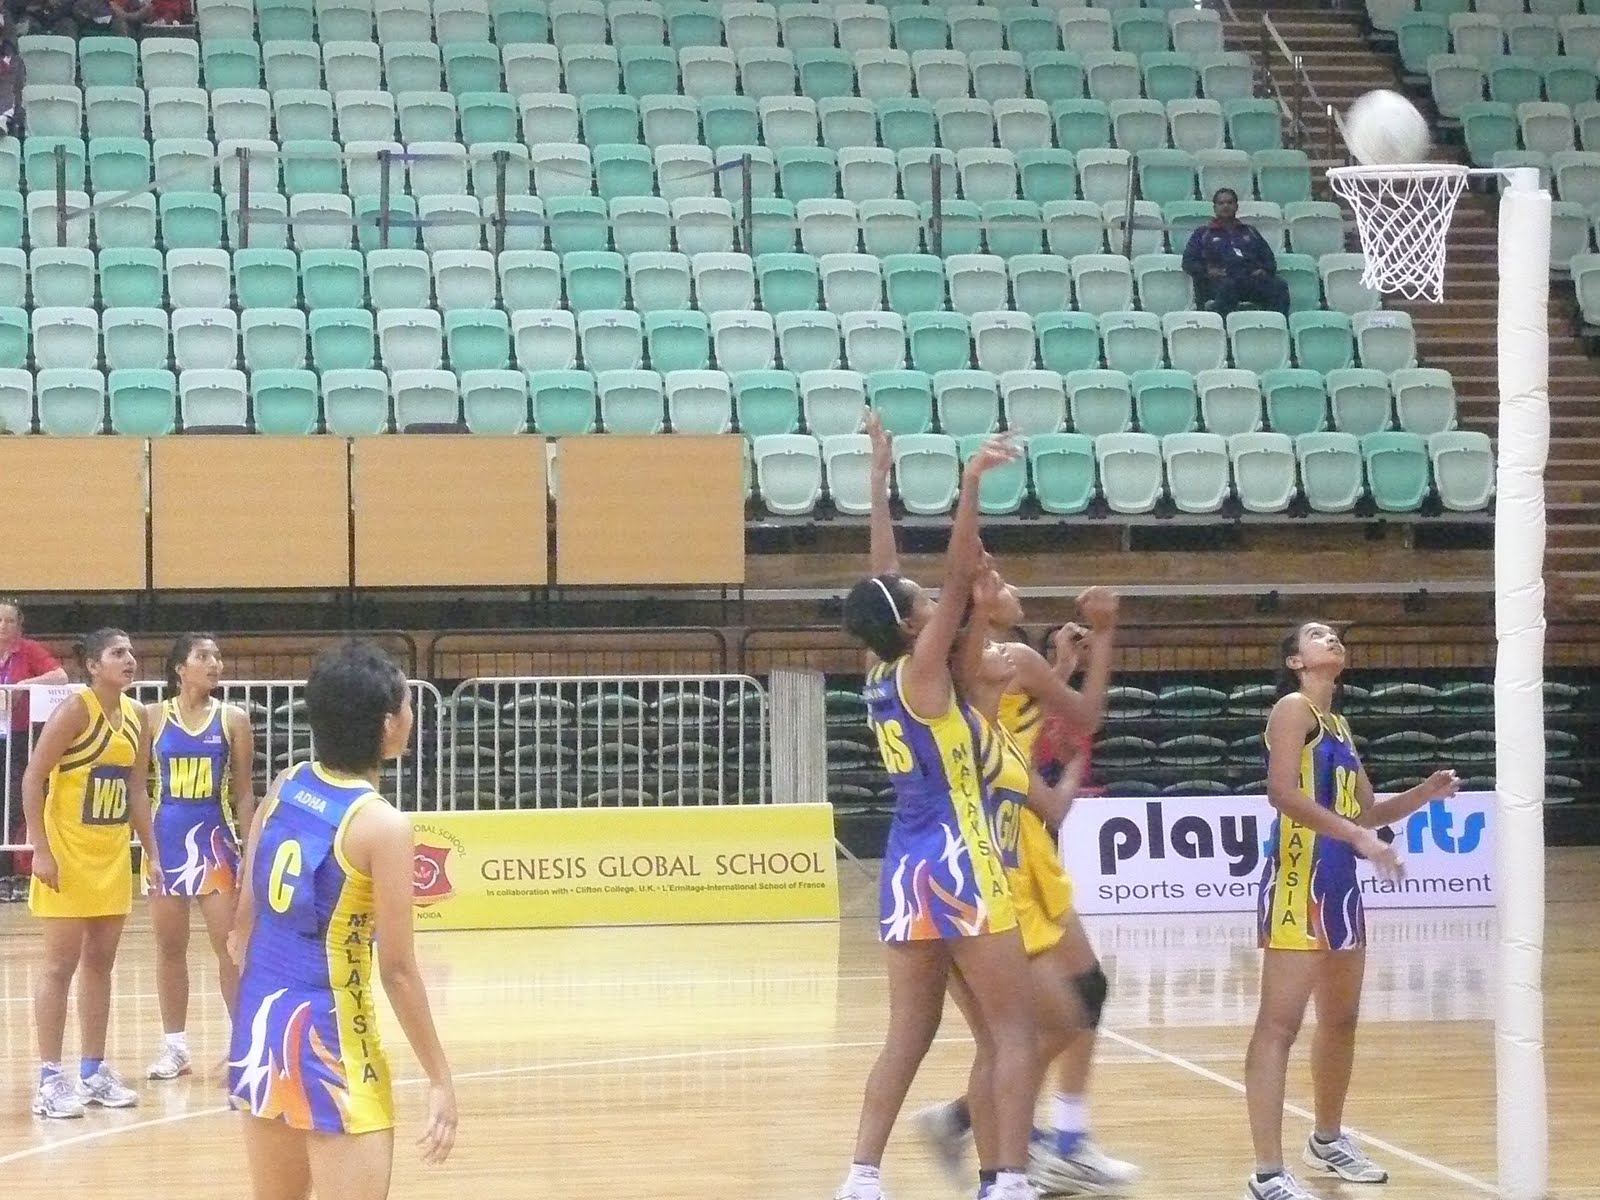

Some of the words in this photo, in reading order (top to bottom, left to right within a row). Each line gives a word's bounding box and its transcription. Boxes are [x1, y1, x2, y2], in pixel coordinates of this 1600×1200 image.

[92, 777, 127, 819] WD
[169, 757, 213, 799] WA
[413, 824, 437, 834] OBAL
[438, 828, 467, 858] SCHOOL
[952, 742, 1004, 898] MALAYSIA
[268, 839, 302, 914] C
[481, 857, 587, 881] GENESIS
[598, 855, 701, 878] GLOBAL
[715, 852, 826, 876] SCHOOL
[496, 888, 550, 896] collaboration
[551, 887, 569, 895] with
[575, 885, 602, 894] Clifton
[758, 882, 787, 890] School
[788, 881, 797, 889] of
[798, 881, 826, 889] France
[1098, 880, 1185, 904] sports
[1195, 882, 1262, 898] even
[344, 914, 379, 1084] MALAYSIA
